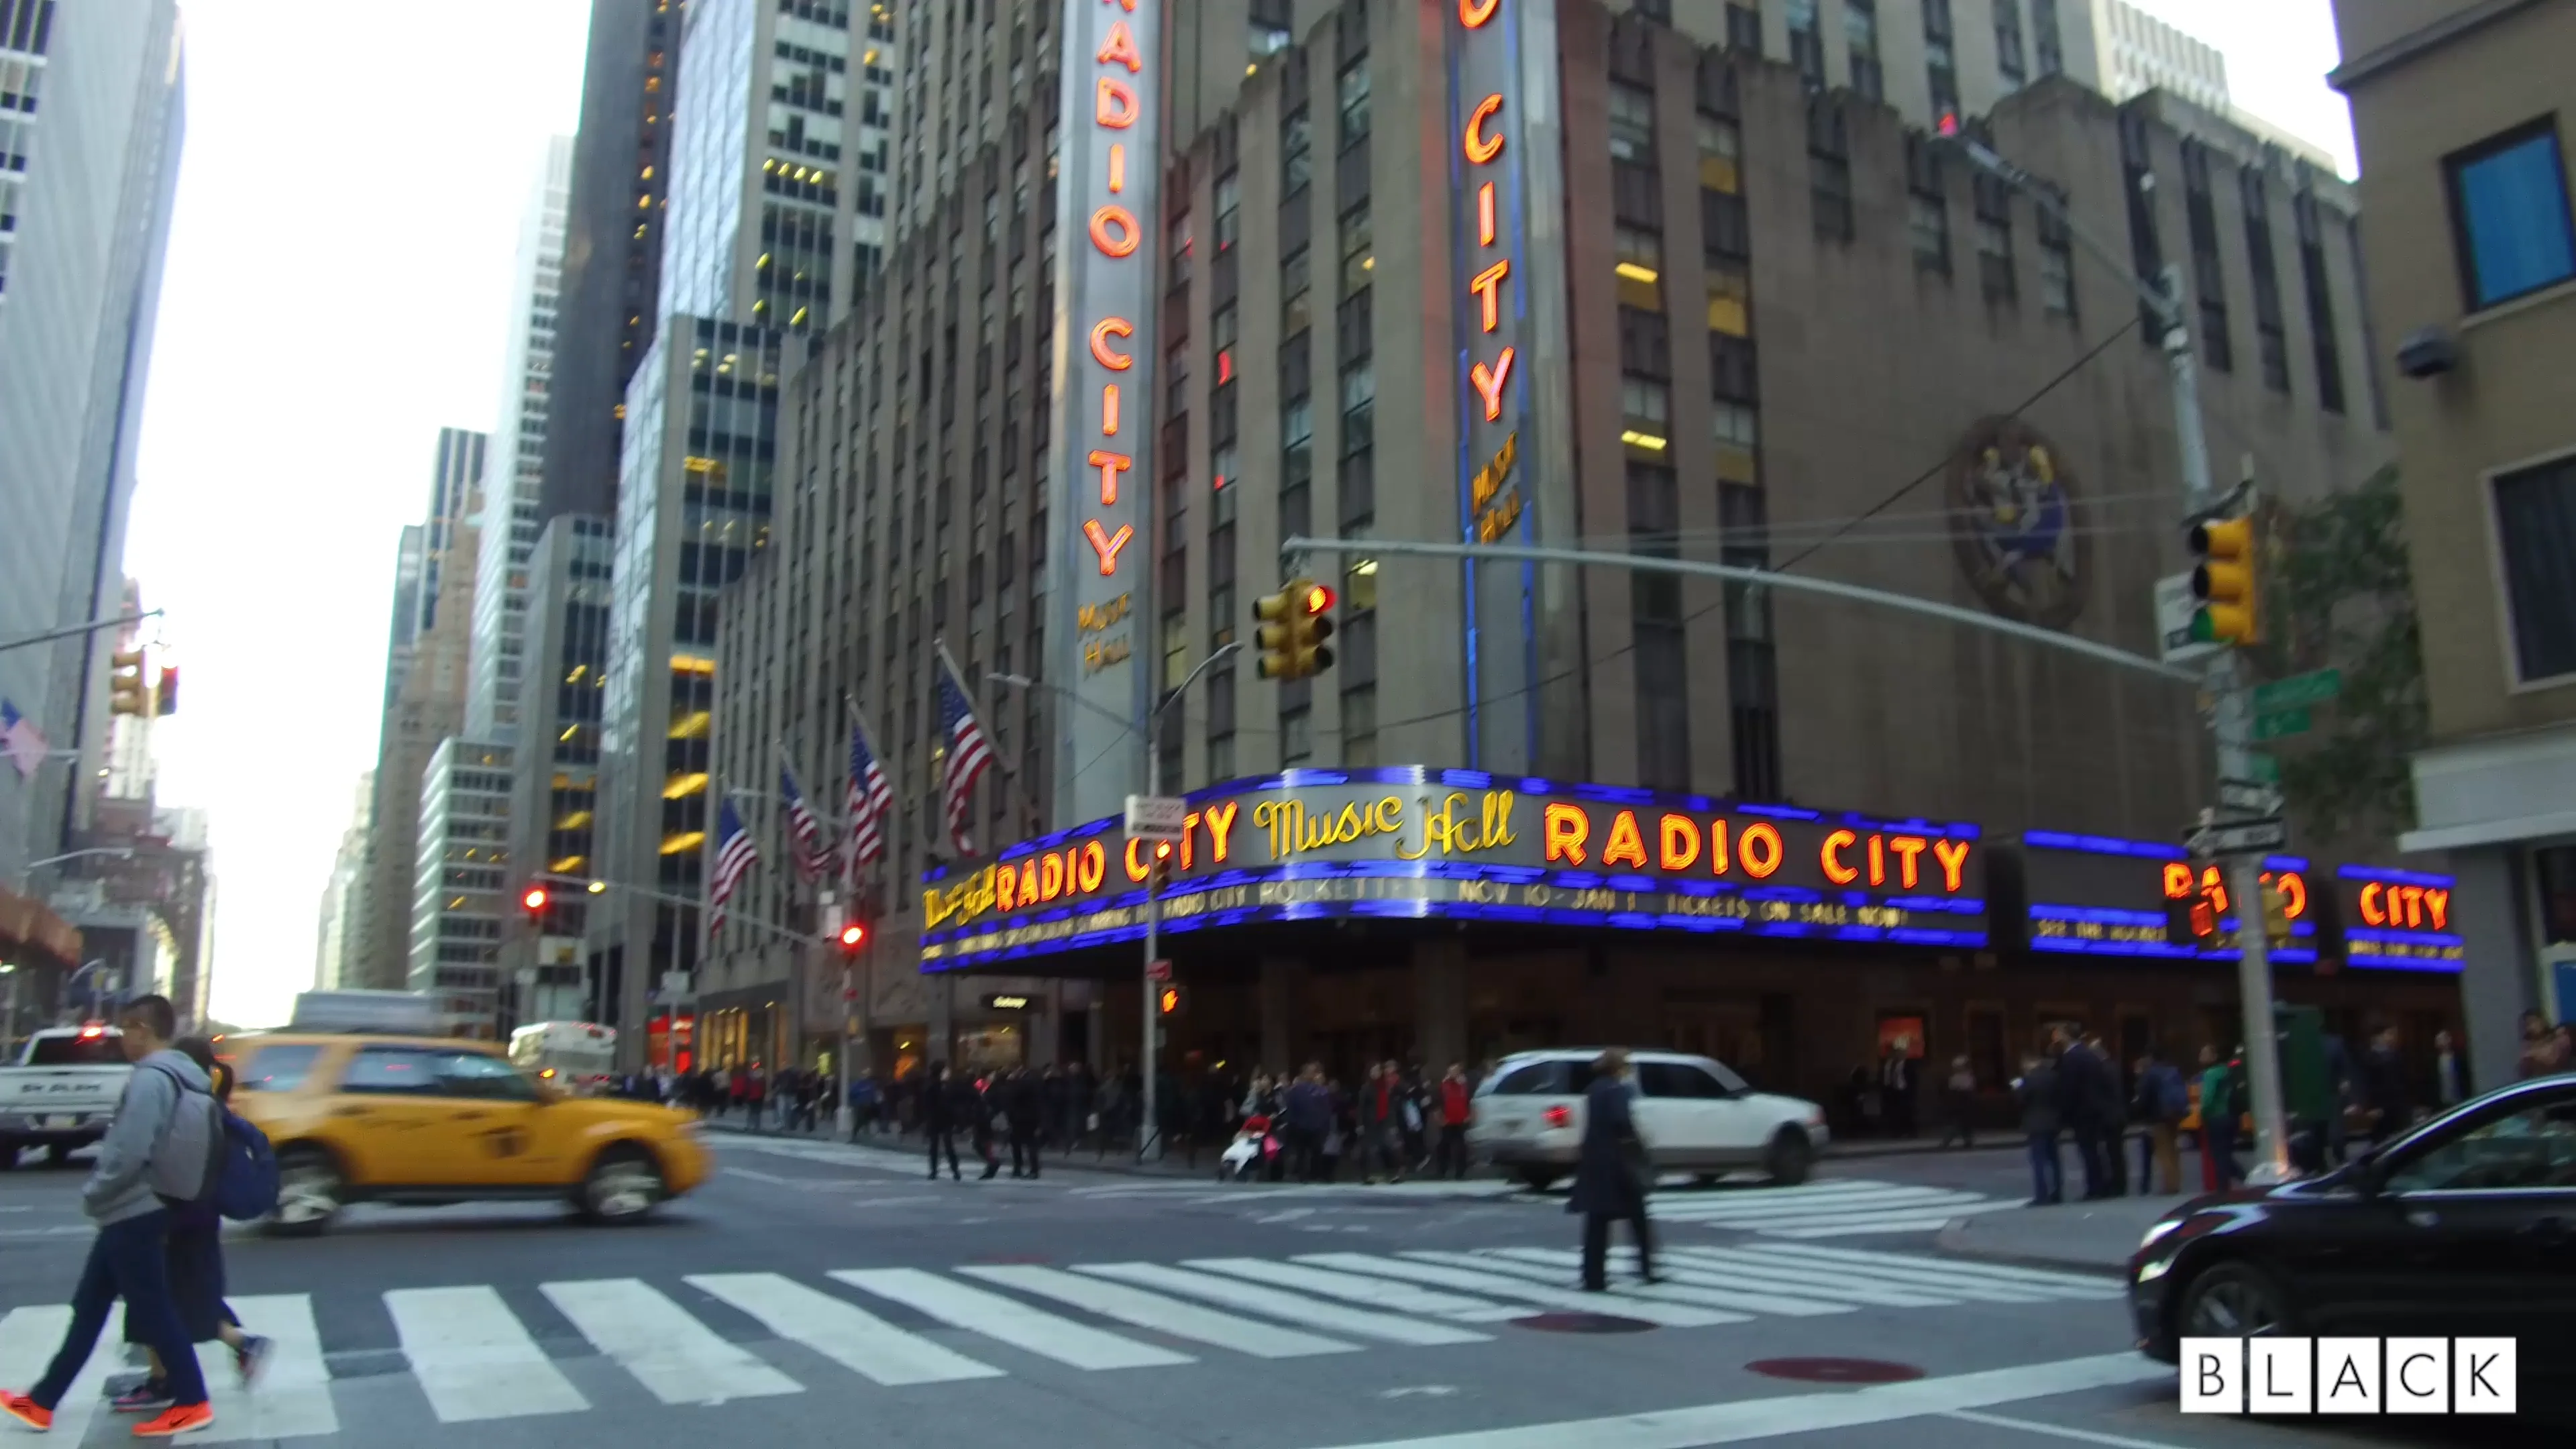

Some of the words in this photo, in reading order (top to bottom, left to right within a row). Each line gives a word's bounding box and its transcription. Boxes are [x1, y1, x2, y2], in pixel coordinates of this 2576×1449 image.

[1089, 0, 1141, 258] ADIO
[1464, 93, 1515, 423] CITY
[1082, 316, 1134, 576] CITY
[997, 839, 1106, 912] RADIO
[1124, 801, 1238, 882] CTY
[1544, 802, 1784, 878] RADIO
[1820, 829, 1970, 892] CITY
[2359, 881, 2449, 930] CITY
